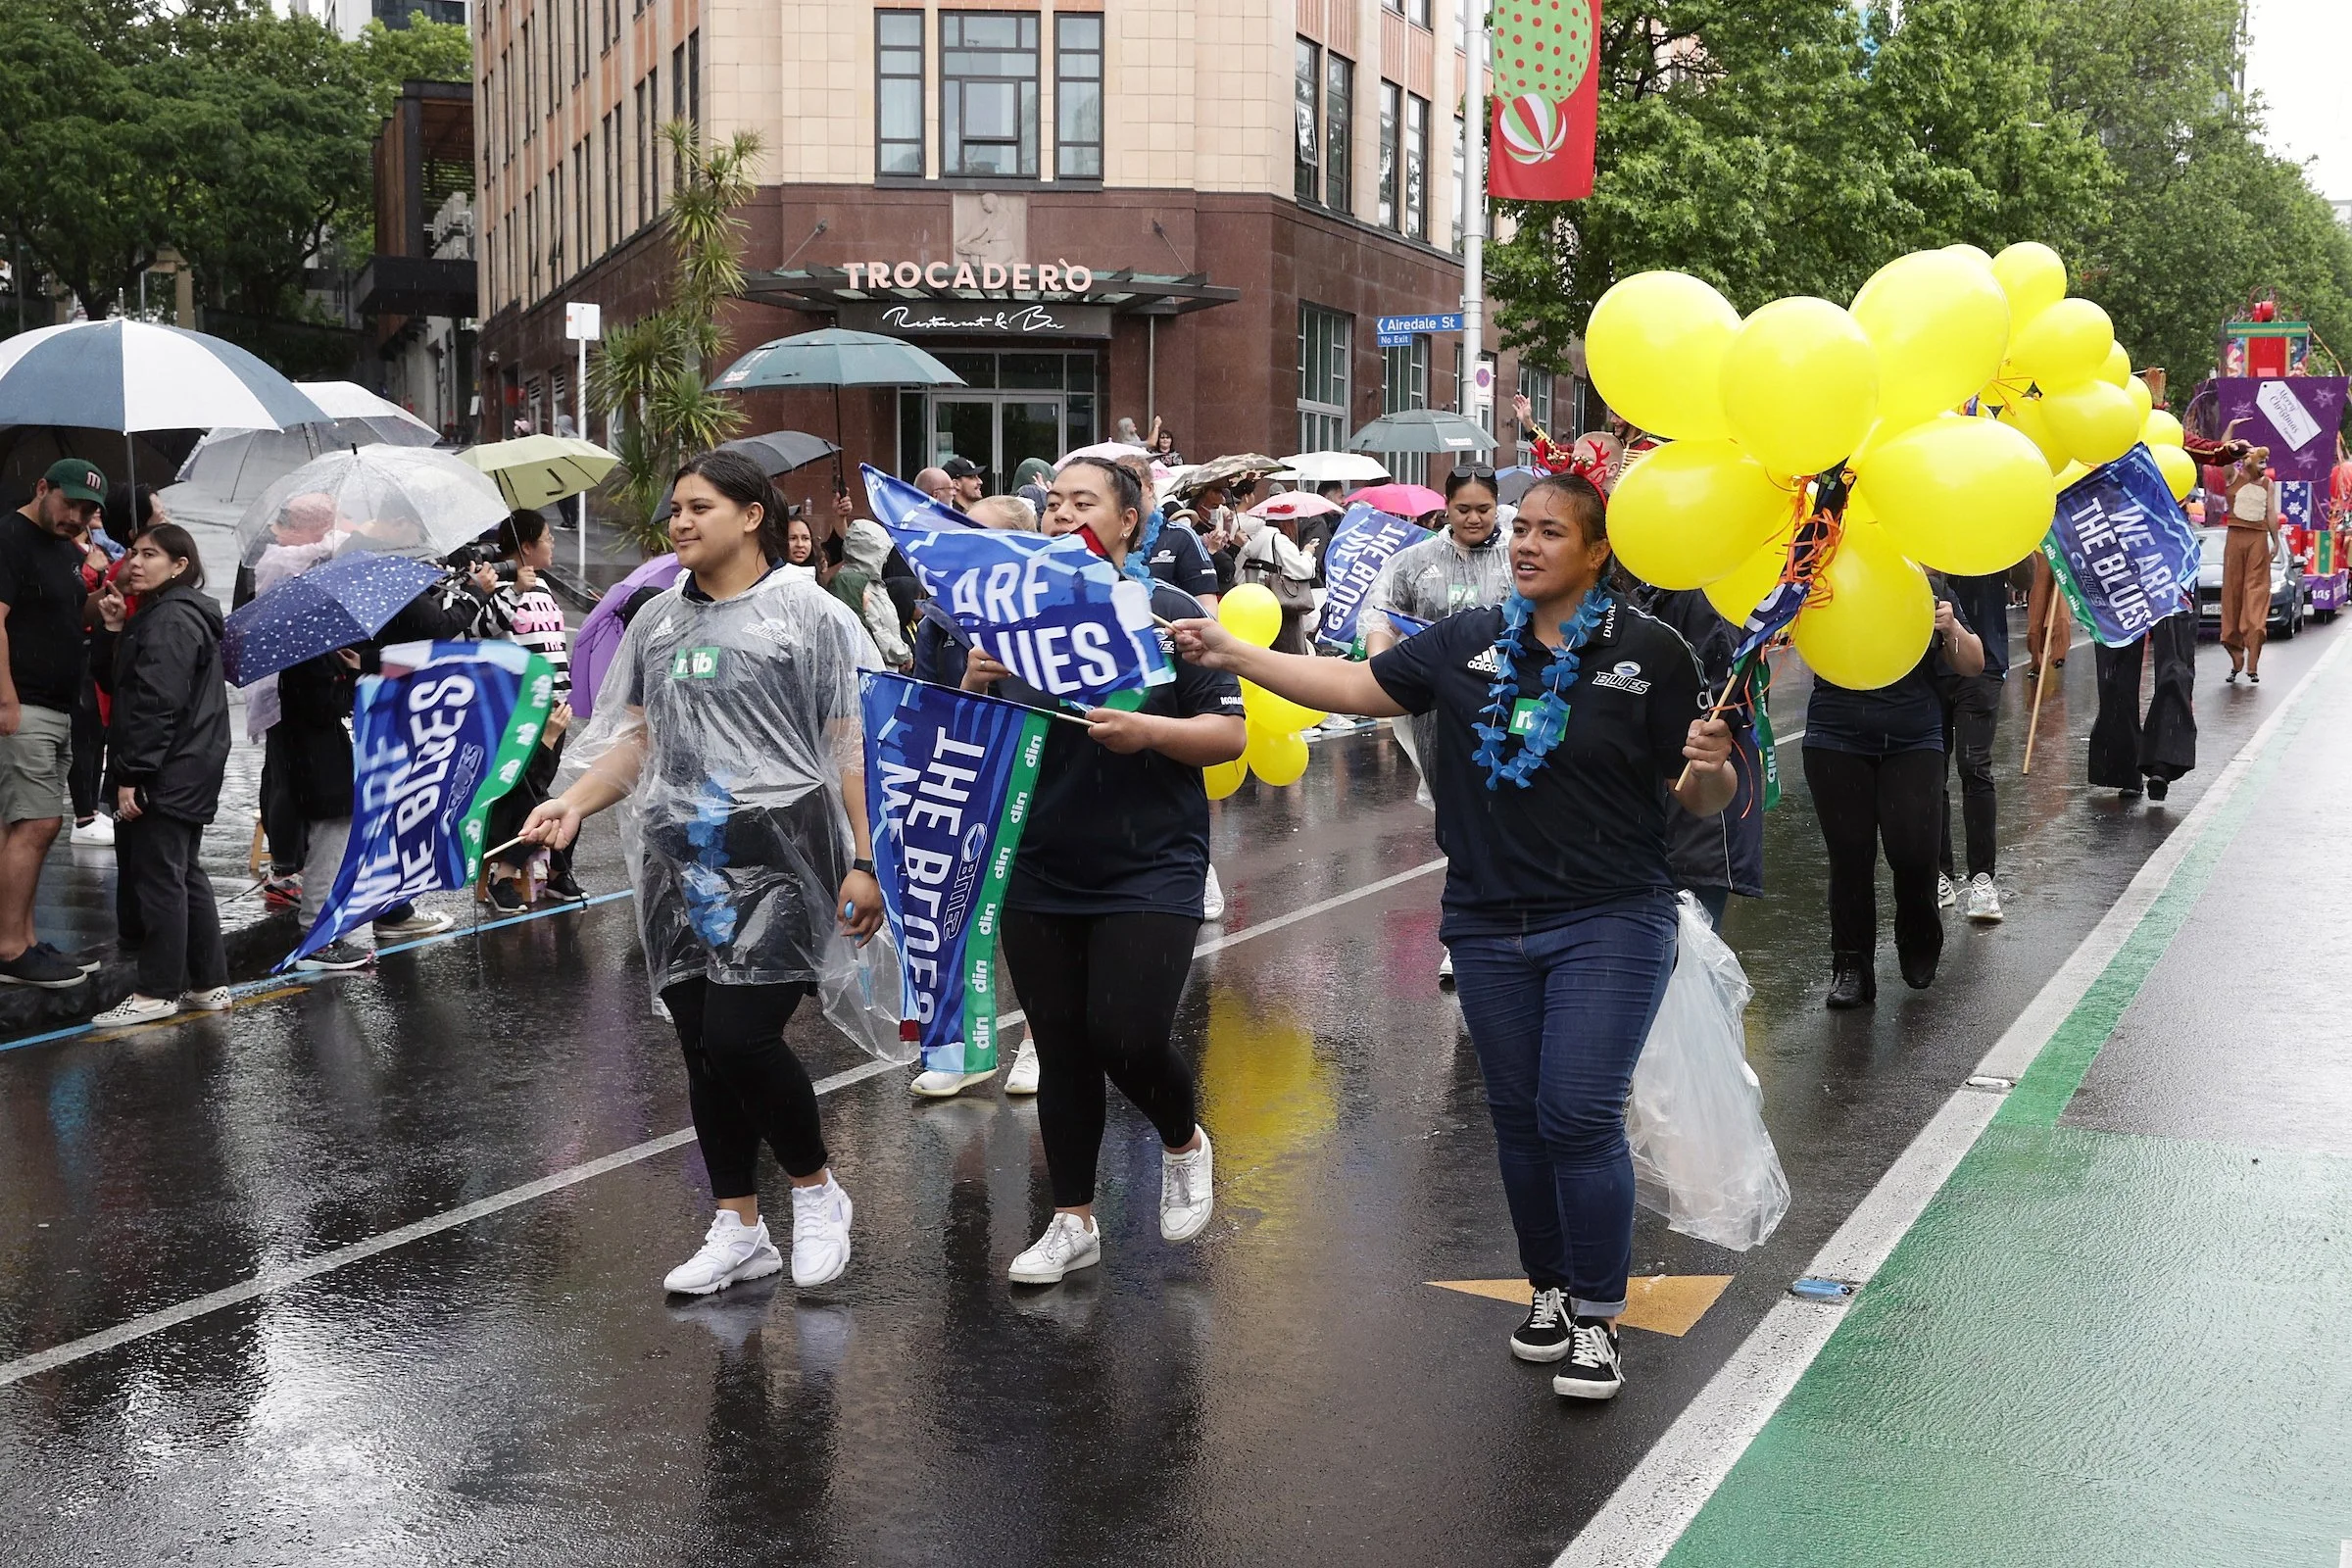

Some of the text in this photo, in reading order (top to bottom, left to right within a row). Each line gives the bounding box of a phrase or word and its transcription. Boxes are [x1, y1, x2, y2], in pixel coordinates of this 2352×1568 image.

[995, 312, 1008, 329] &
[1008, 305, 1066, 331] Bar
[1387, 317, 1455, 331] Airedale St
[1381, 335, 1408, 344] No Exit
[2108, 505, 2156, 552] WE
[2044, 543, 2057, 561] nib
[2071, 496, 2153, 631] THE BLUES
[2055, 568, 2067, 586] nib
[2069, 594, 2081, 612] nib
[1603, 603, 1616, 638] DUVAL
[1592, 671, 1651, 695] BLUES
[1767, 746, 1777, 783] nib
